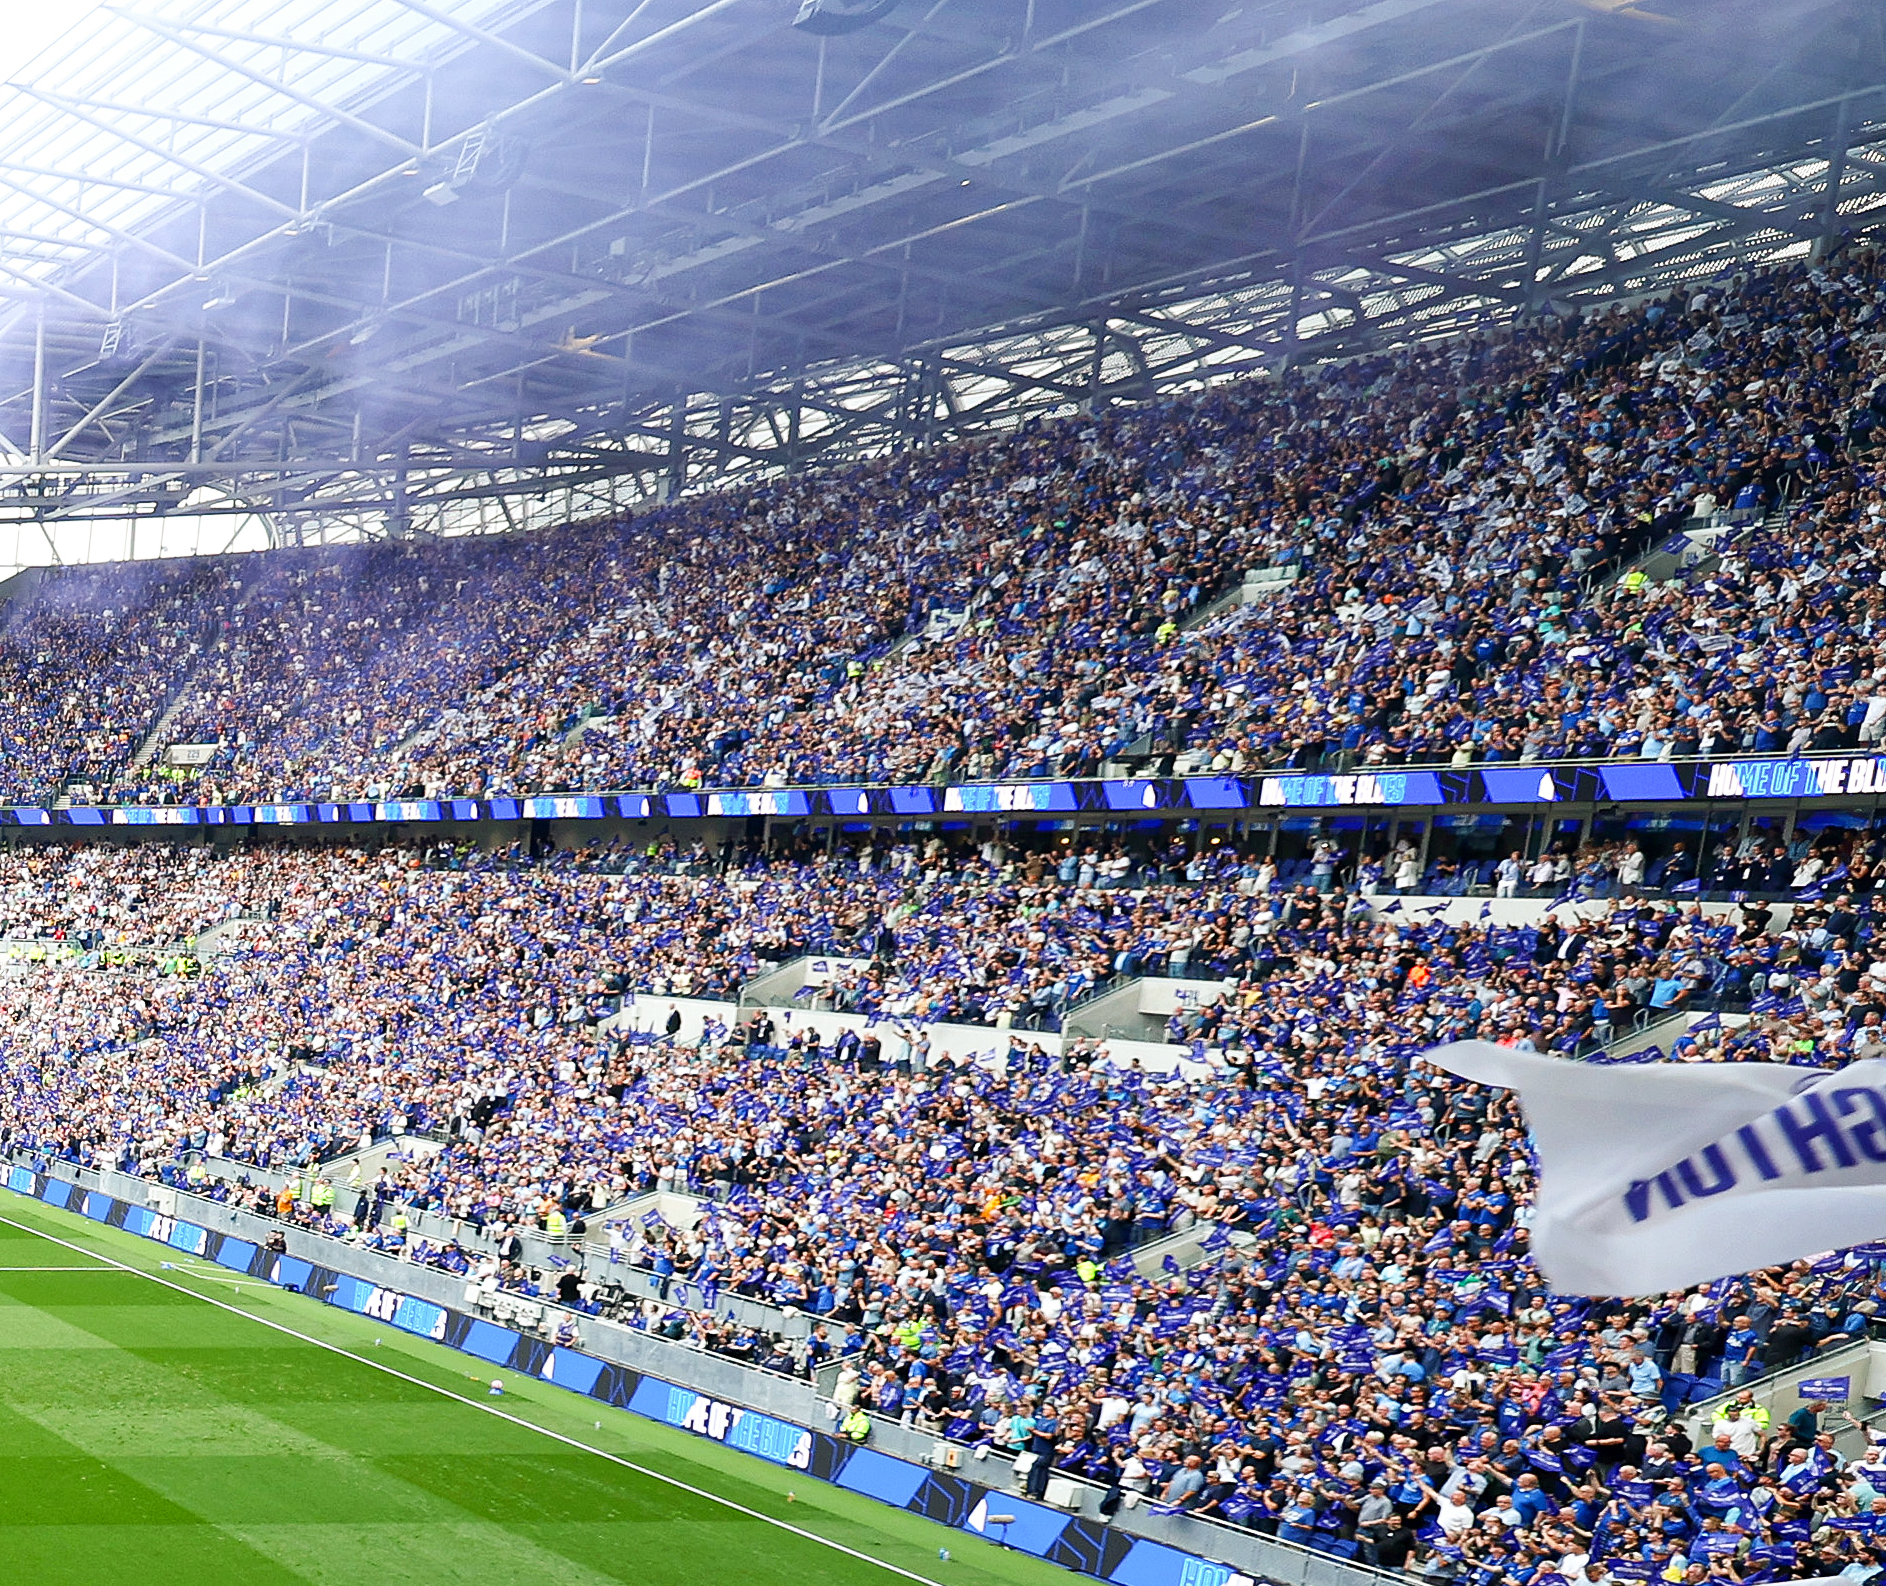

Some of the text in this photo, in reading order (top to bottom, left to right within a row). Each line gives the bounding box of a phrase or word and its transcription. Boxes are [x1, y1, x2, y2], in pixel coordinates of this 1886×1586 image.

[1707, 762, 1771, 797] HOME
[1770, 761, 1801, 796] OF
[1804, 759, 1849, 795] THE
[707, 1402, 731, 1440] OF
